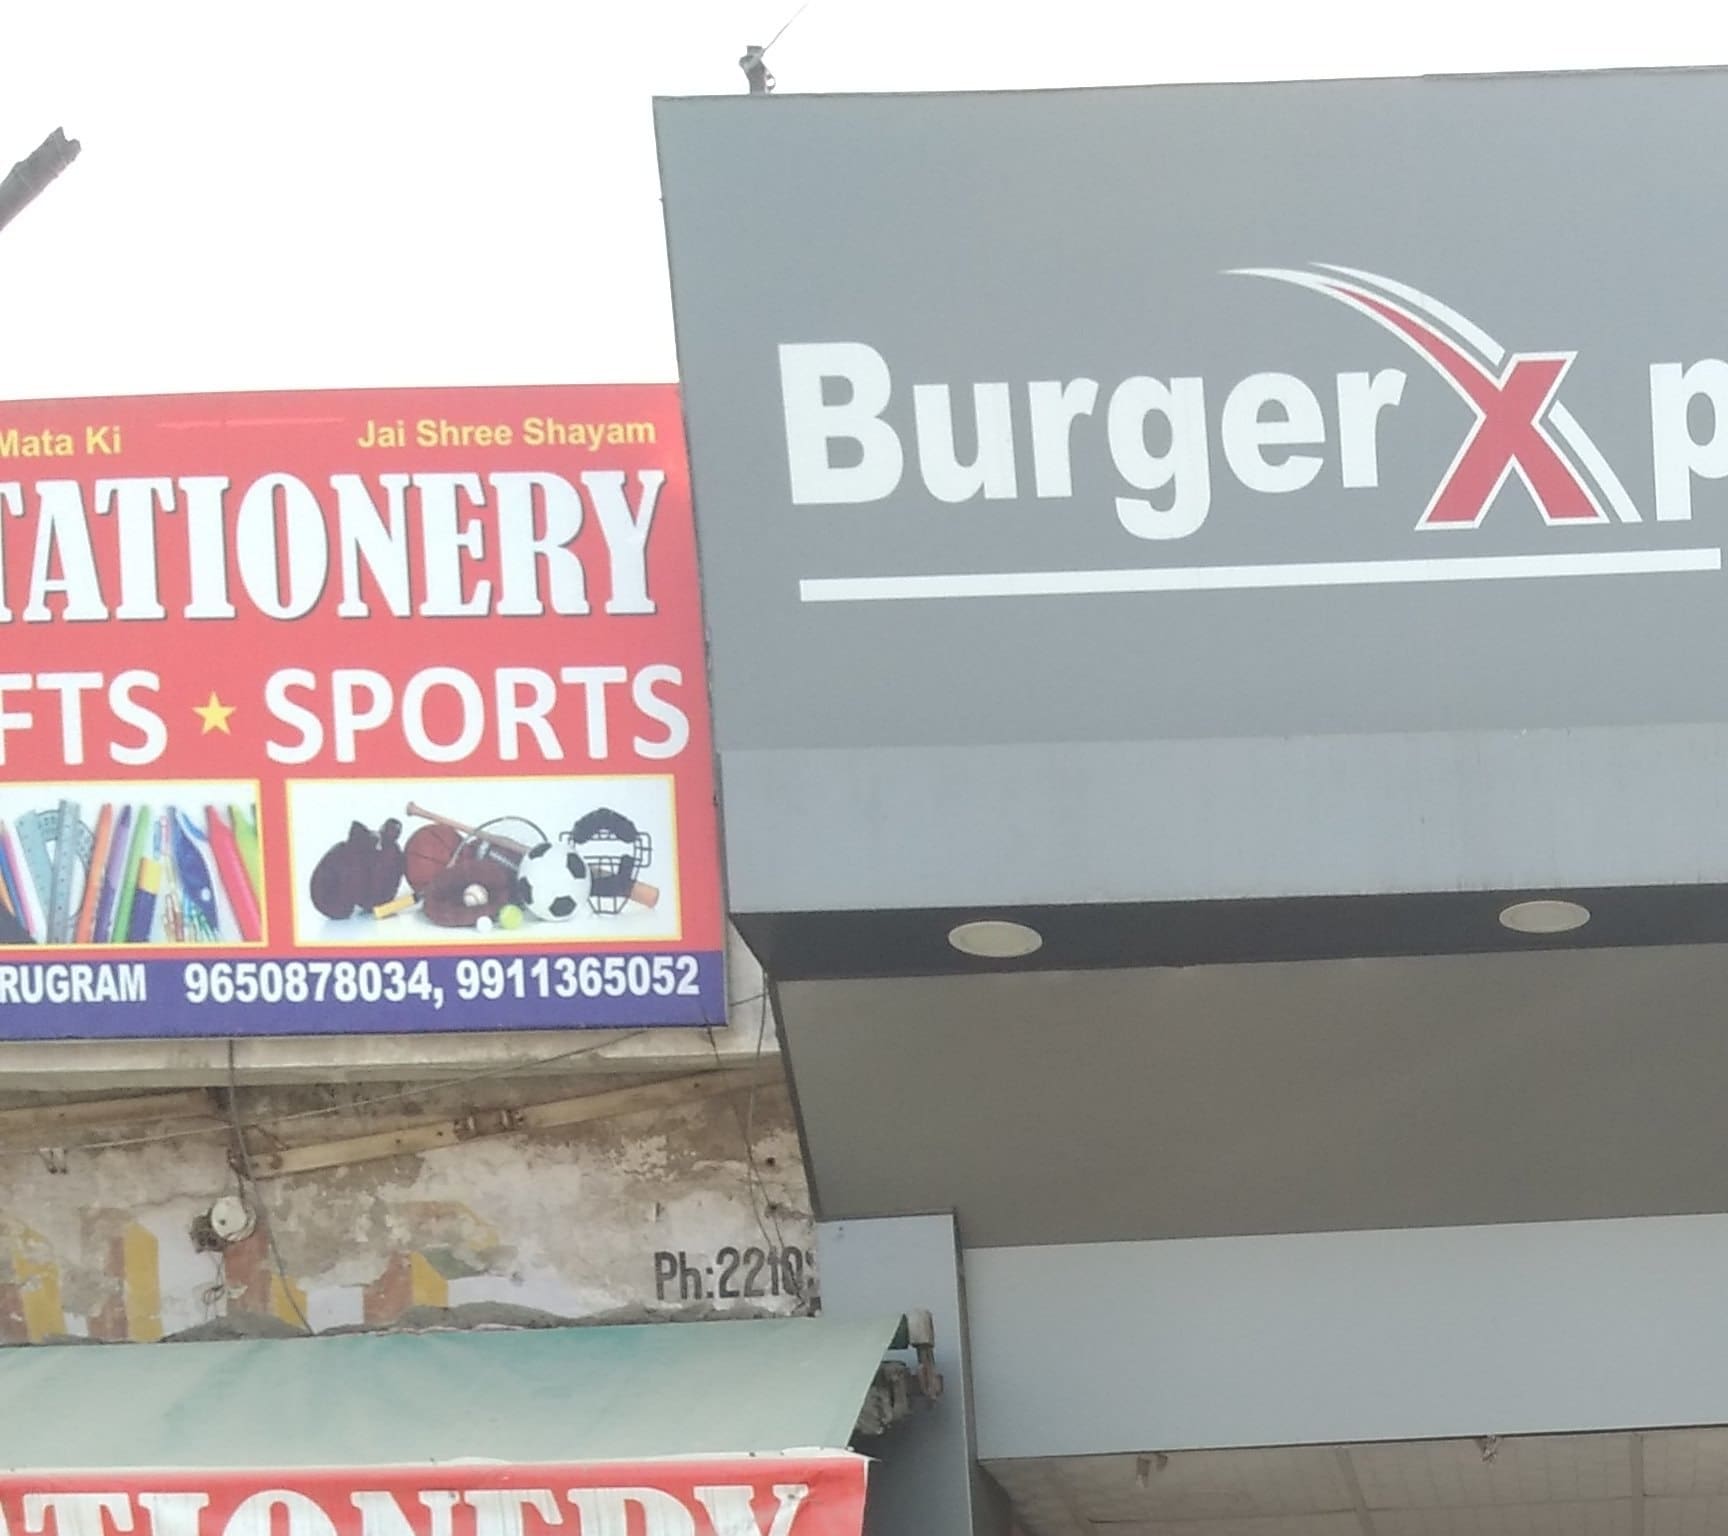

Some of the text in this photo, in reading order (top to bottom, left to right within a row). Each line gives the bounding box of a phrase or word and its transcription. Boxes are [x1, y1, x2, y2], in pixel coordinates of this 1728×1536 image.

[0, 427, 121, 457] Mata Ki
[358, 417, 657, 452] Jai Shree Shayam
[264, 664, 691, 764] SPORTS
[185, 960, 443, 1010] 9650878034,
[457, 955, 700, 1000] 9911365052
